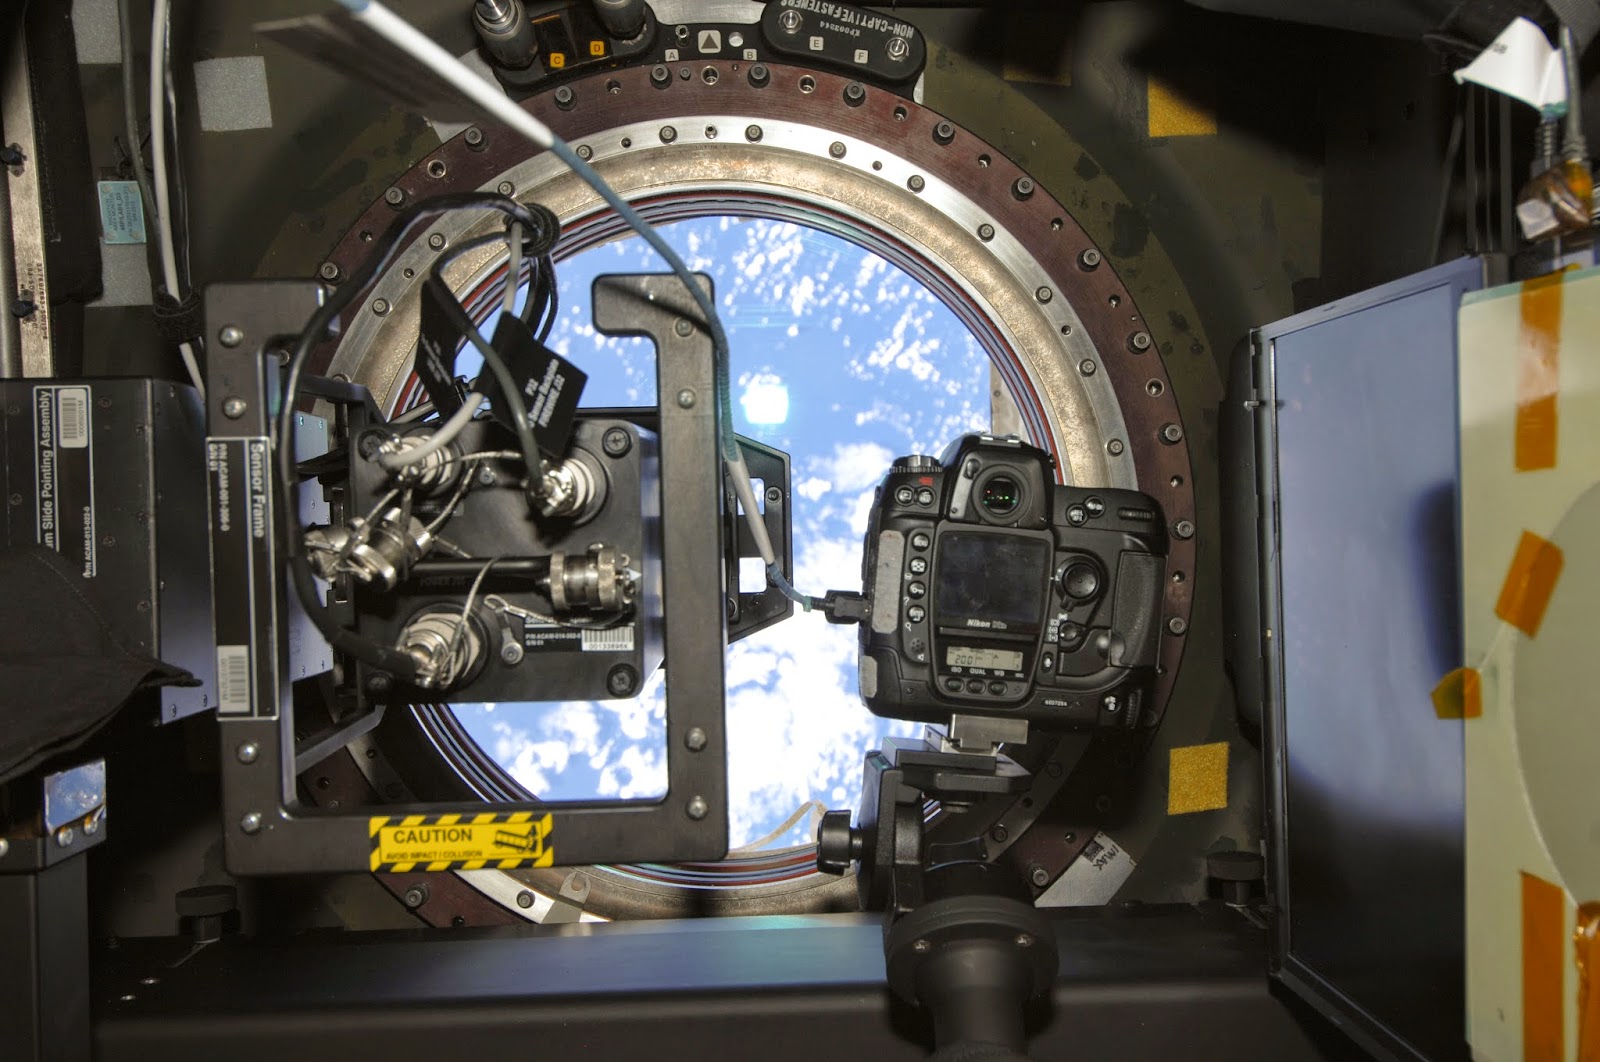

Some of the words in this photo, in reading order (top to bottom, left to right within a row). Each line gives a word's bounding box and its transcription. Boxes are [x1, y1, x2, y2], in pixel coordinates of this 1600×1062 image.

[39, 390, 52, 448] Assembly
[41, 449, 54, 498] Pointing
[250, 443, 265, 492] Sensor
[42, 500, 54, 530] Slide
[252, 494, 266, 538] Frame
[966, 619, 991, 628] Nikon
[954, 654, 973, 665] 200
[950, 666, 962, 674] ISO
[969, 667, 987, 676] QUAL
[993, 669, 1005, 677] WB
[393, 828, 473, 844] CAUTION
[386, 852, 409, 860] AVOID
[410, 851, 437, 859] IMPACT
[443, 850, 483, 859] COLLISION
